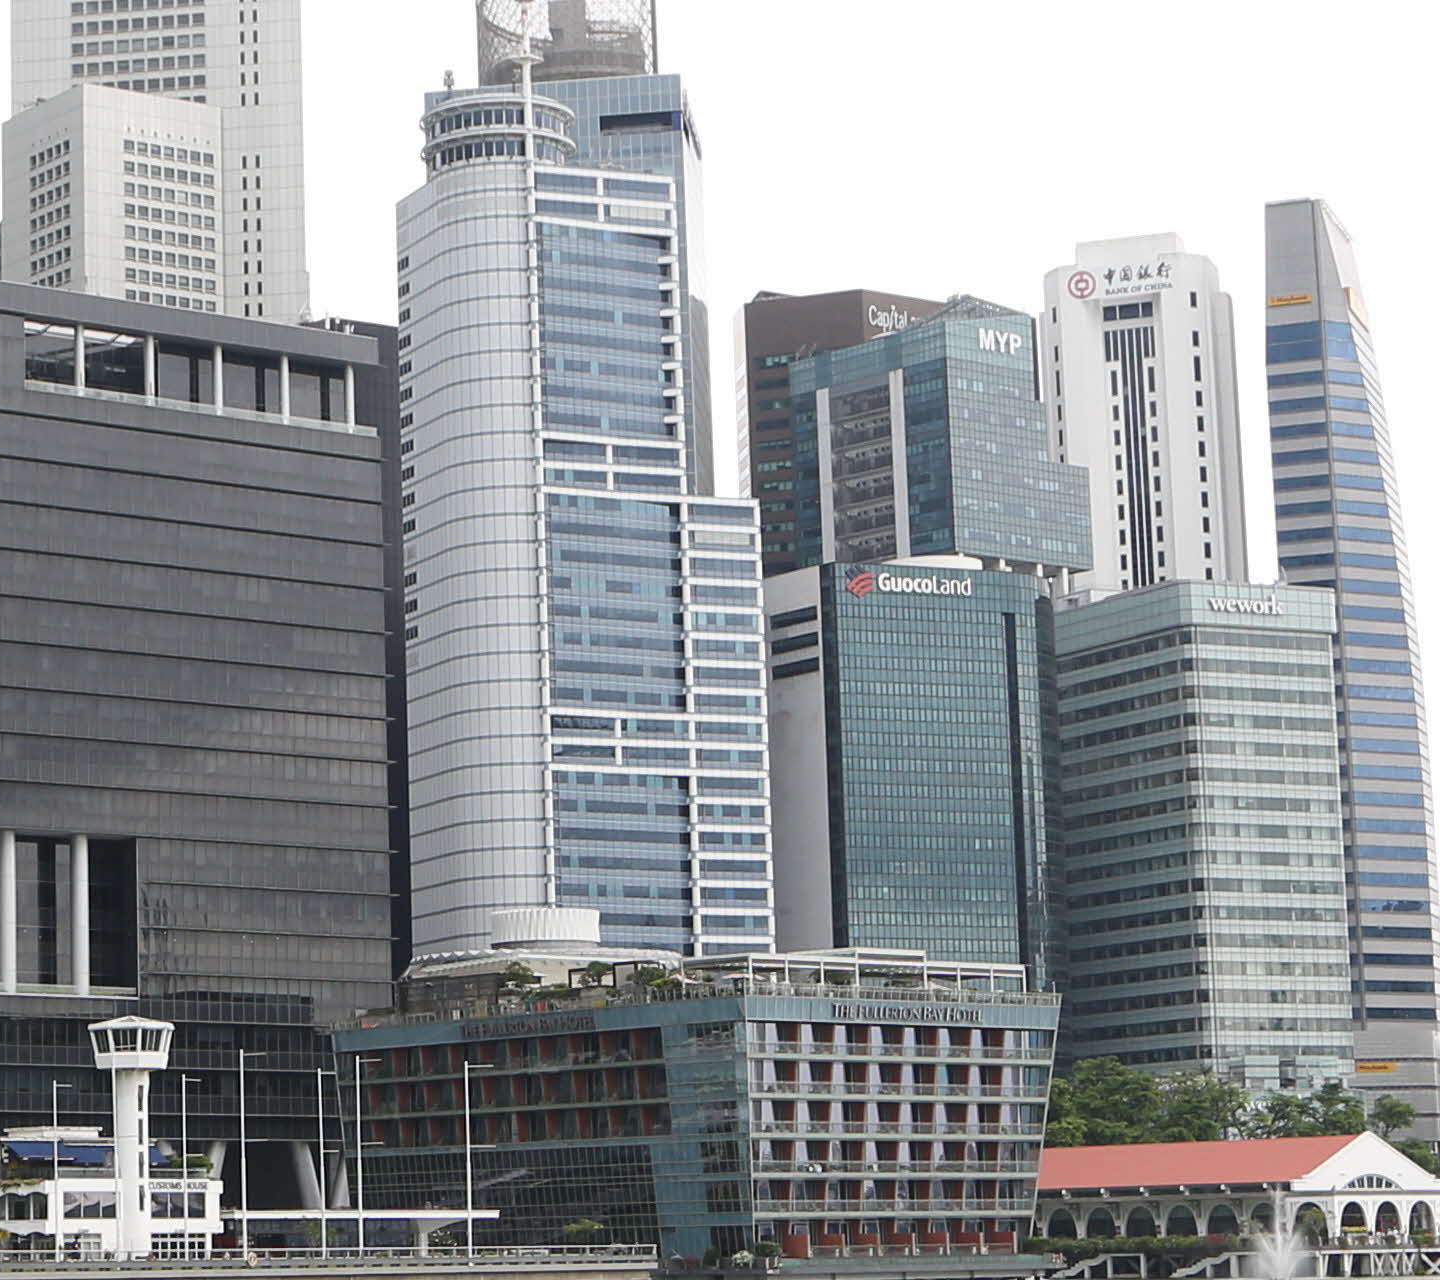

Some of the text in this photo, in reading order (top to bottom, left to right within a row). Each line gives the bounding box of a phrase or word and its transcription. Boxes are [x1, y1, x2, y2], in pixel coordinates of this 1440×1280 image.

[1106, 282, 1173, 296] BANK OF CHINA
[978, 327, 1021, 354] MYP
[878, 573, 972, 596] GuocoLand
[1209, 593, 1282, 615] wework
[833, 1002, 983, 1023] THE FULLERTON BAY HOTEL
